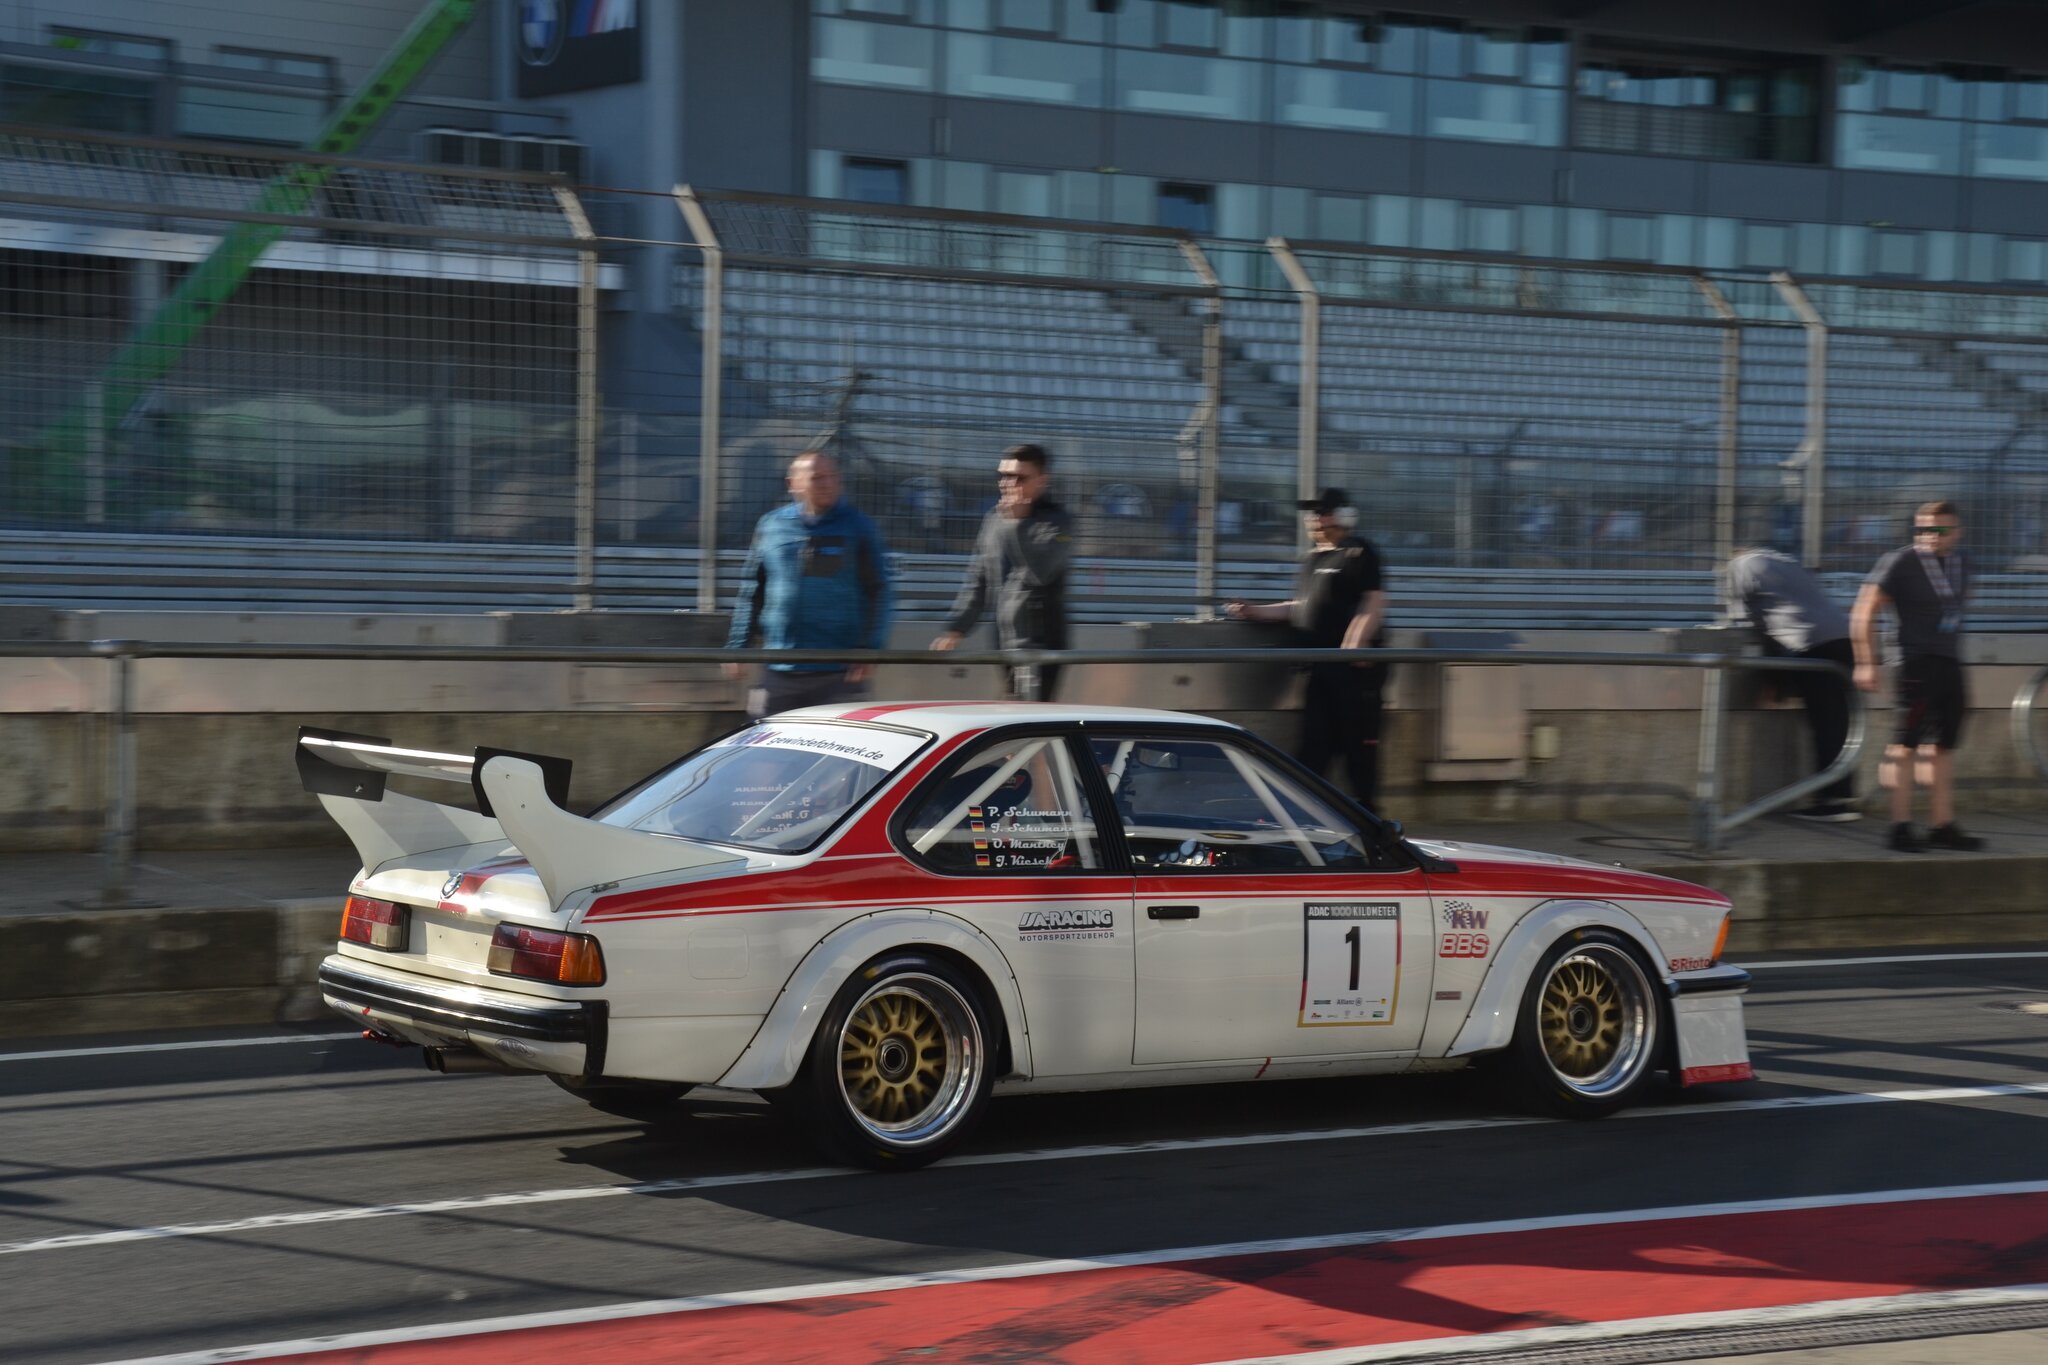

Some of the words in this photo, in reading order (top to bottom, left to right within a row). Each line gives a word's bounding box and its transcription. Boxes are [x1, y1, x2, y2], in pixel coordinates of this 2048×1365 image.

[767, 737, 884, 761] gewindefahrwerk.de
[987, 806, 1000, 817] P.
[1308, 906, 1330, 916] ADAC
[1331, 906, 1352, 916] 1000
[1353, 906, 1397, 916] KILOMETER
[1451, 910, 1490, 929] KW
[1439, 933, 1490, 958] BBS
[1345, 926, 1361, 990] 1
